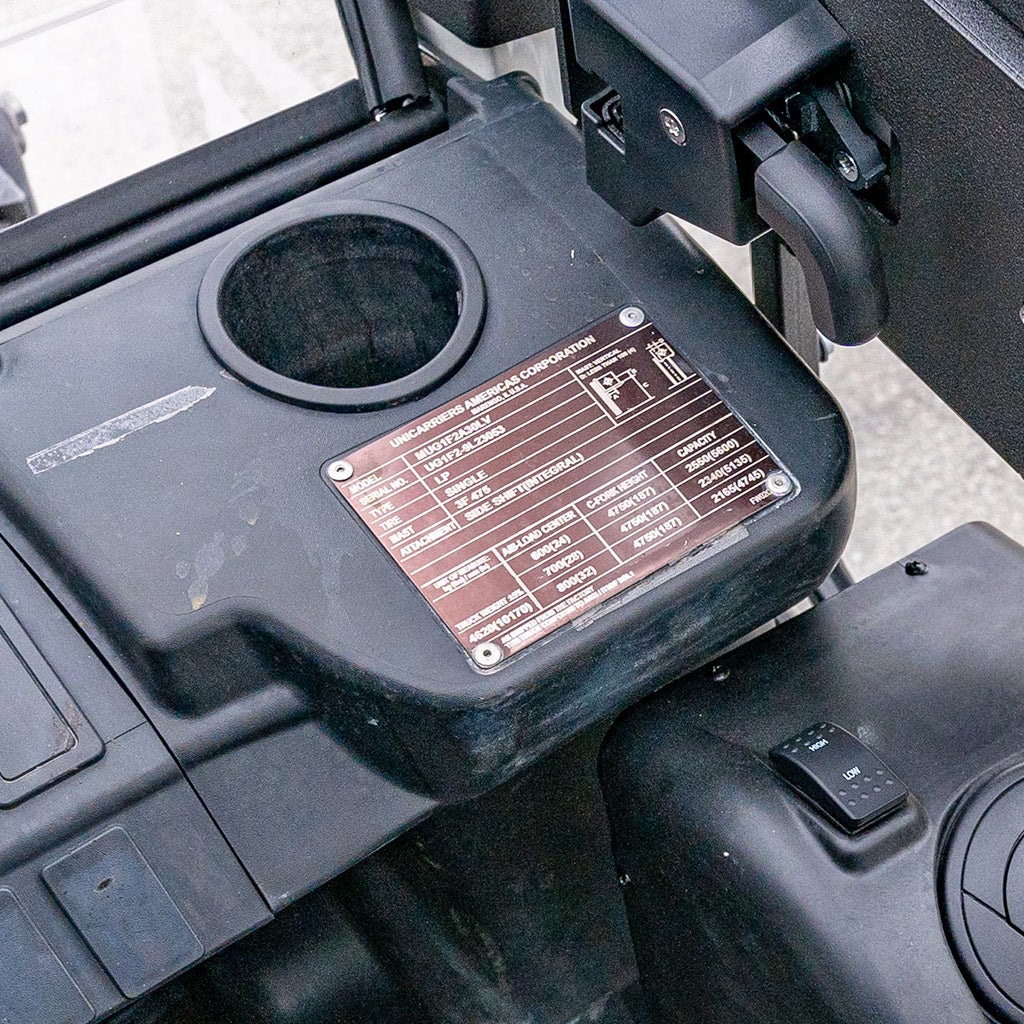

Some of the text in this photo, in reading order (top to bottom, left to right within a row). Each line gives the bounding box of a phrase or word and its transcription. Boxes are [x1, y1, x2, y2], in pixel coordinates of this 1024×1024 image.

[387, 334, 596, 448] UNICARRIERS AMERICAS CORPORATION
[414, 414, 491, 460] MUG1F2A30LV
[676, 430, 716, 457] CAPACITY
[684, 438, 739, 473] 2550(5600)
[347, 473, 382, 494] MODEL
[433, 471, 450, 485] LP
[444, 469, 488, 497] SINGLE
[697, 453, 752, 488] 2340(5135)
[358, 477, 408, 506] SERIAL NO.
[453, 484, 491, 509] 3F 475
[585, 469, 648, 509] C-FORK HEIGHT
[710, 468, 765, 503] 2165(4745)
[368, 500, 395, 518] TYPE
[463, 501, 493, 521] SIDE
[540, 510, 577, 533] CENTER
[378, 515, 403, 531] TIRE
[388, 525, 415, 544] MAST
[399, 520, 456, 557] ATTACHMENT
[542, 549, 584, 576] 700(28)
[555, 565, 597, 592] 800(32)
[809, 738, 829, 752] HIGH
[842, 765, 862, 781] LOW
